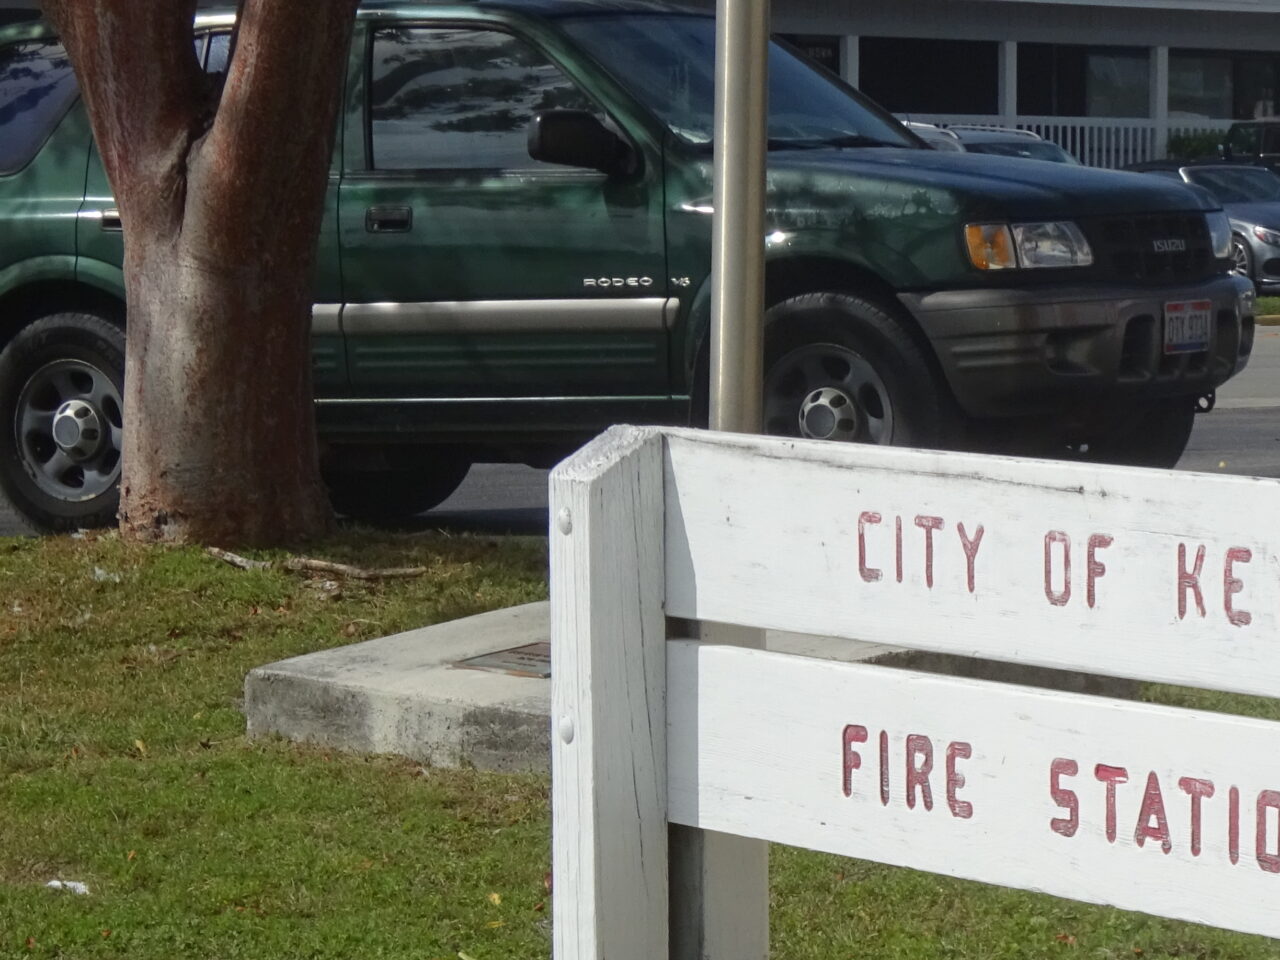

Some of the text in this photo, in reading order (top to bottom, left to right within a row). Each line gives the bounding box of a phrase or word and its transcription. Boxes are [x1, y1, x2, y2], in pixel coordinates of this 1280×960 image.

[1154, 239, 1187, 252] ISUZU
[584, 276, 653, 287] RODEO
[857, 511, 985, 593] CITY
[1044, 530, 1113, 608] OF
[842, 724, 973, 818] FIRE
